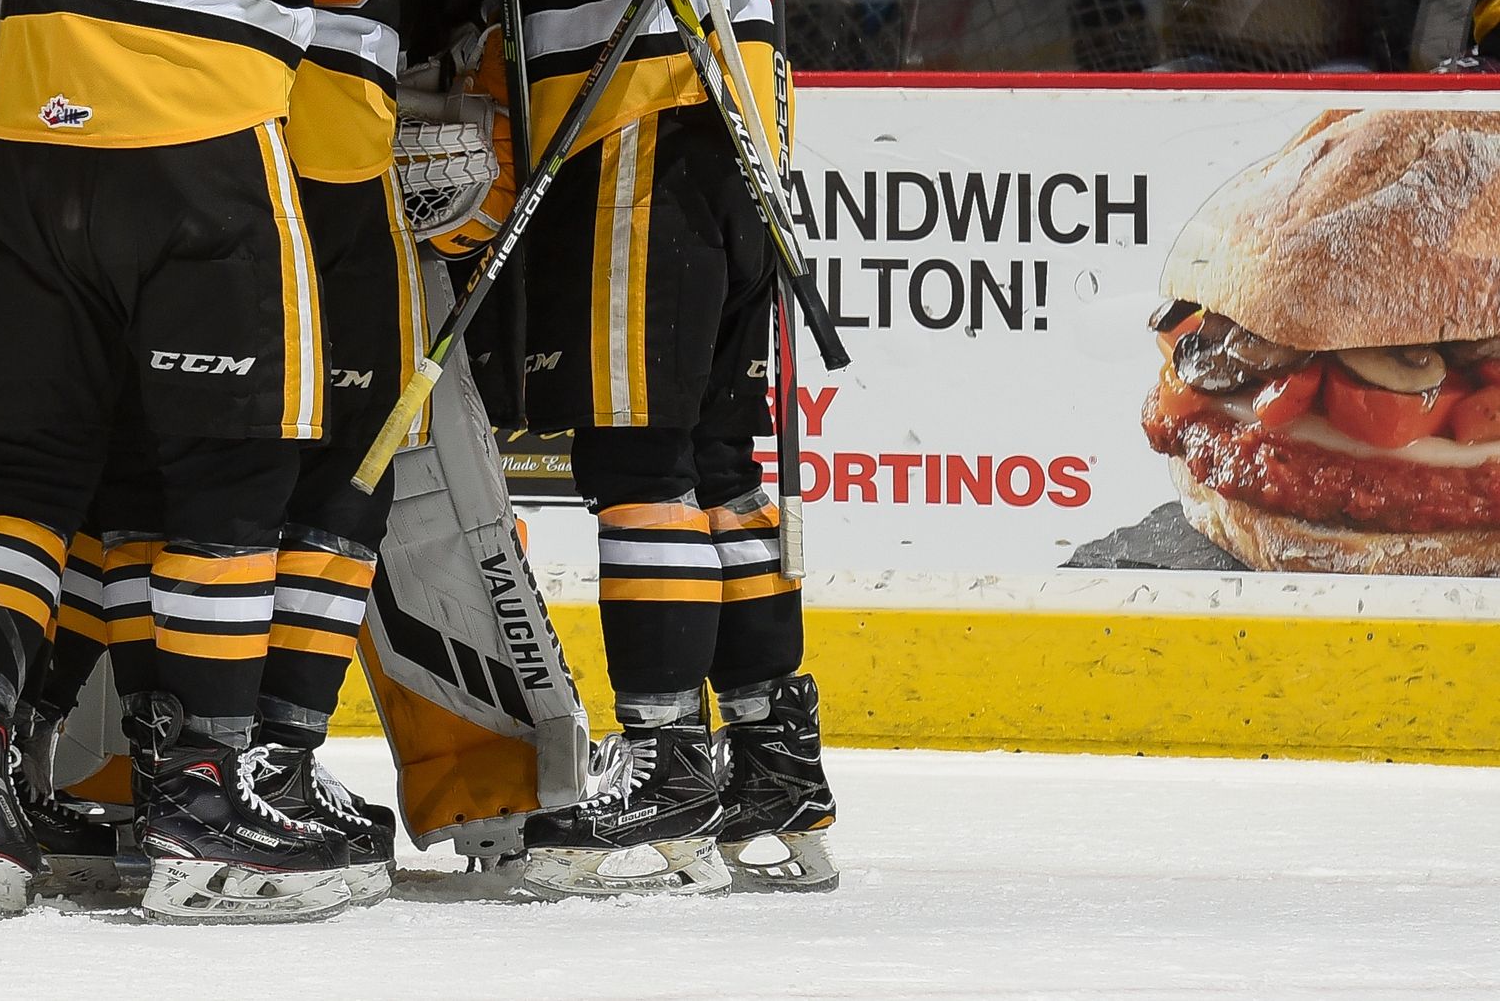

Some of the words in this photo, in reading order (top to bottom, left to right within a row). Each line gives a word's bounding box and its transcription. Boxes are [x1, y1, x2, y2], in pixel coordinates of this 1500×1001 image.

[487, 173, 553, 281] RIBCOR
[790, 170, 1149, 245] ANDWICH
[151, 350, 256, 377] CCM
[480, 552, 554, 690] VAUGHN
